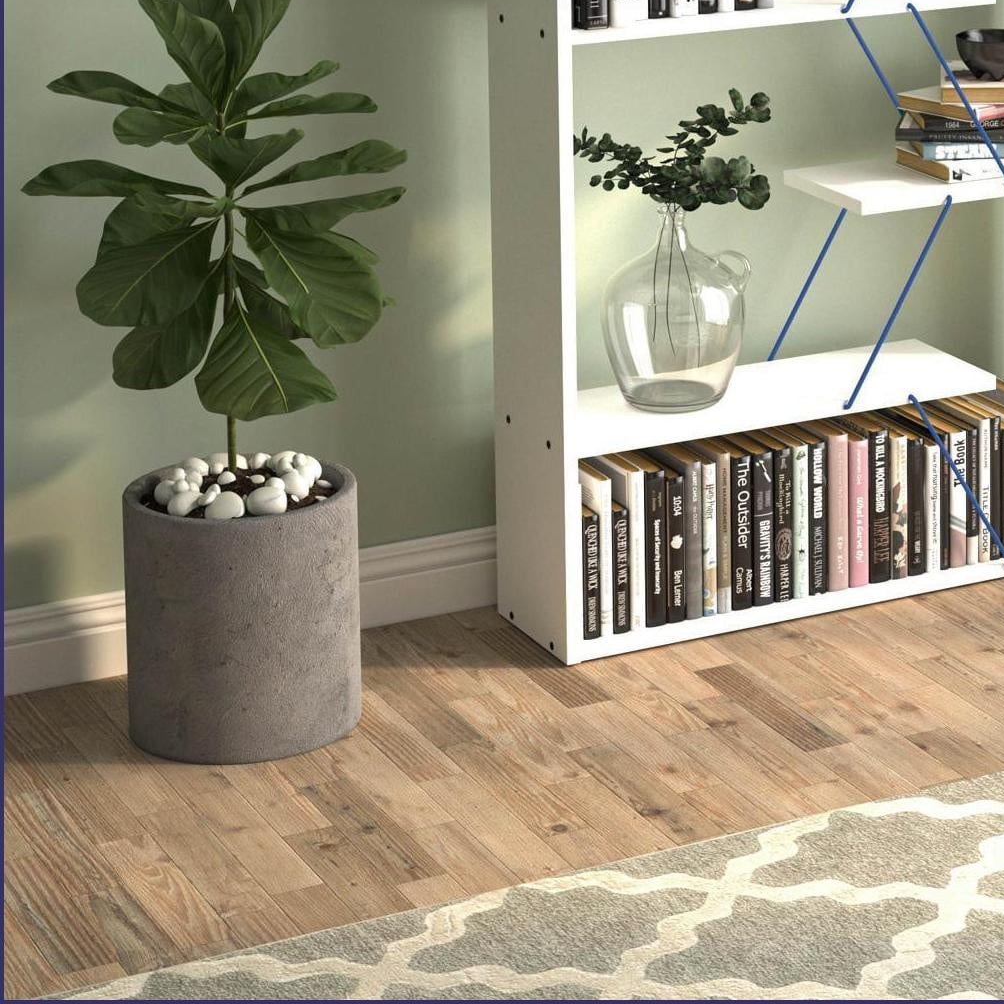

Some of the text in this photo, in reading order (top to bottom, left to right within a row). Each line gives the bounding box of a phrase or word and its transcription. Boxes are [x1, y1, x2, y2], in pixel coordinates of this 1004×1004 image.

[970, 120, 999, 128] GORGE
[875, 435, 884, 444] TO
[876, 445, 885, 460] KILL
[954, 440, 965, 465] Book
[814, 448, 822, 519] HOLLOW WORLD
[876, 467, 885, 513] MOCKINGBIRD
[673, 495, 682, 516] 10:04
[738, 462, 750, 548] The Outsider
[585, 525, 597, 556] QUENCHED
[615, 519, 627, 551] QUENCHED
[760, 519, 770, 559] GRAVITY'S
[814, 526, 822, 553] MICHAEL
[874, 516, 890, 564] HARPER LEE
[588, 574, 597, 590] WICK
[618, 568, 627, 585] WICK
[674, 570, 683, 606] Ben Lerner
[760, 561, 770, 597] RAINBOW
[780, 564, 790, 589] HARPER
